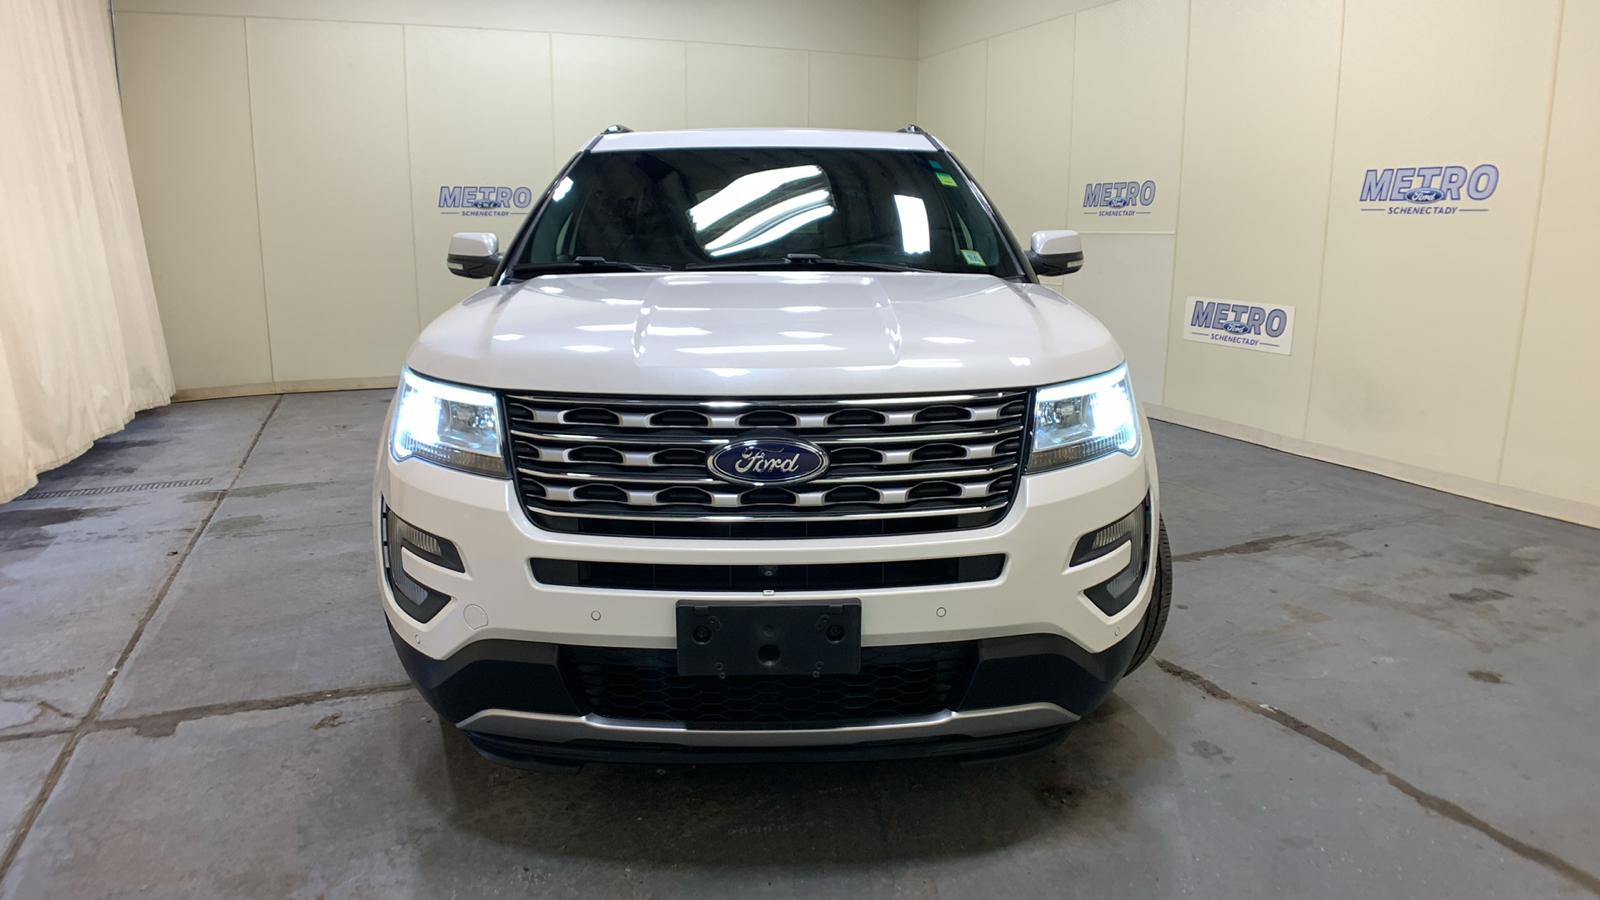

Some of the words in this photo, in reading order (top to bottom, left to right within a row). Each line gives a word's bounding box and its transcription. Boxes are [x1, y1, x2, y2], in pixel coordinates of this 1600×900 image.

[1083, 180, 1156, 207] METRO
[1360, 164, 1499, 202] METRO
[438, 186, 532, 208] METRO
[1411, 190, 1437, 201] Ford
[1387, 206, 1458, 215] SCHENECTADY
[1190, 300, 1287, 338] METRO
[1210, 333, 1259, 346] SCHENECTADY
[735, 447, 800, 473] Ford
